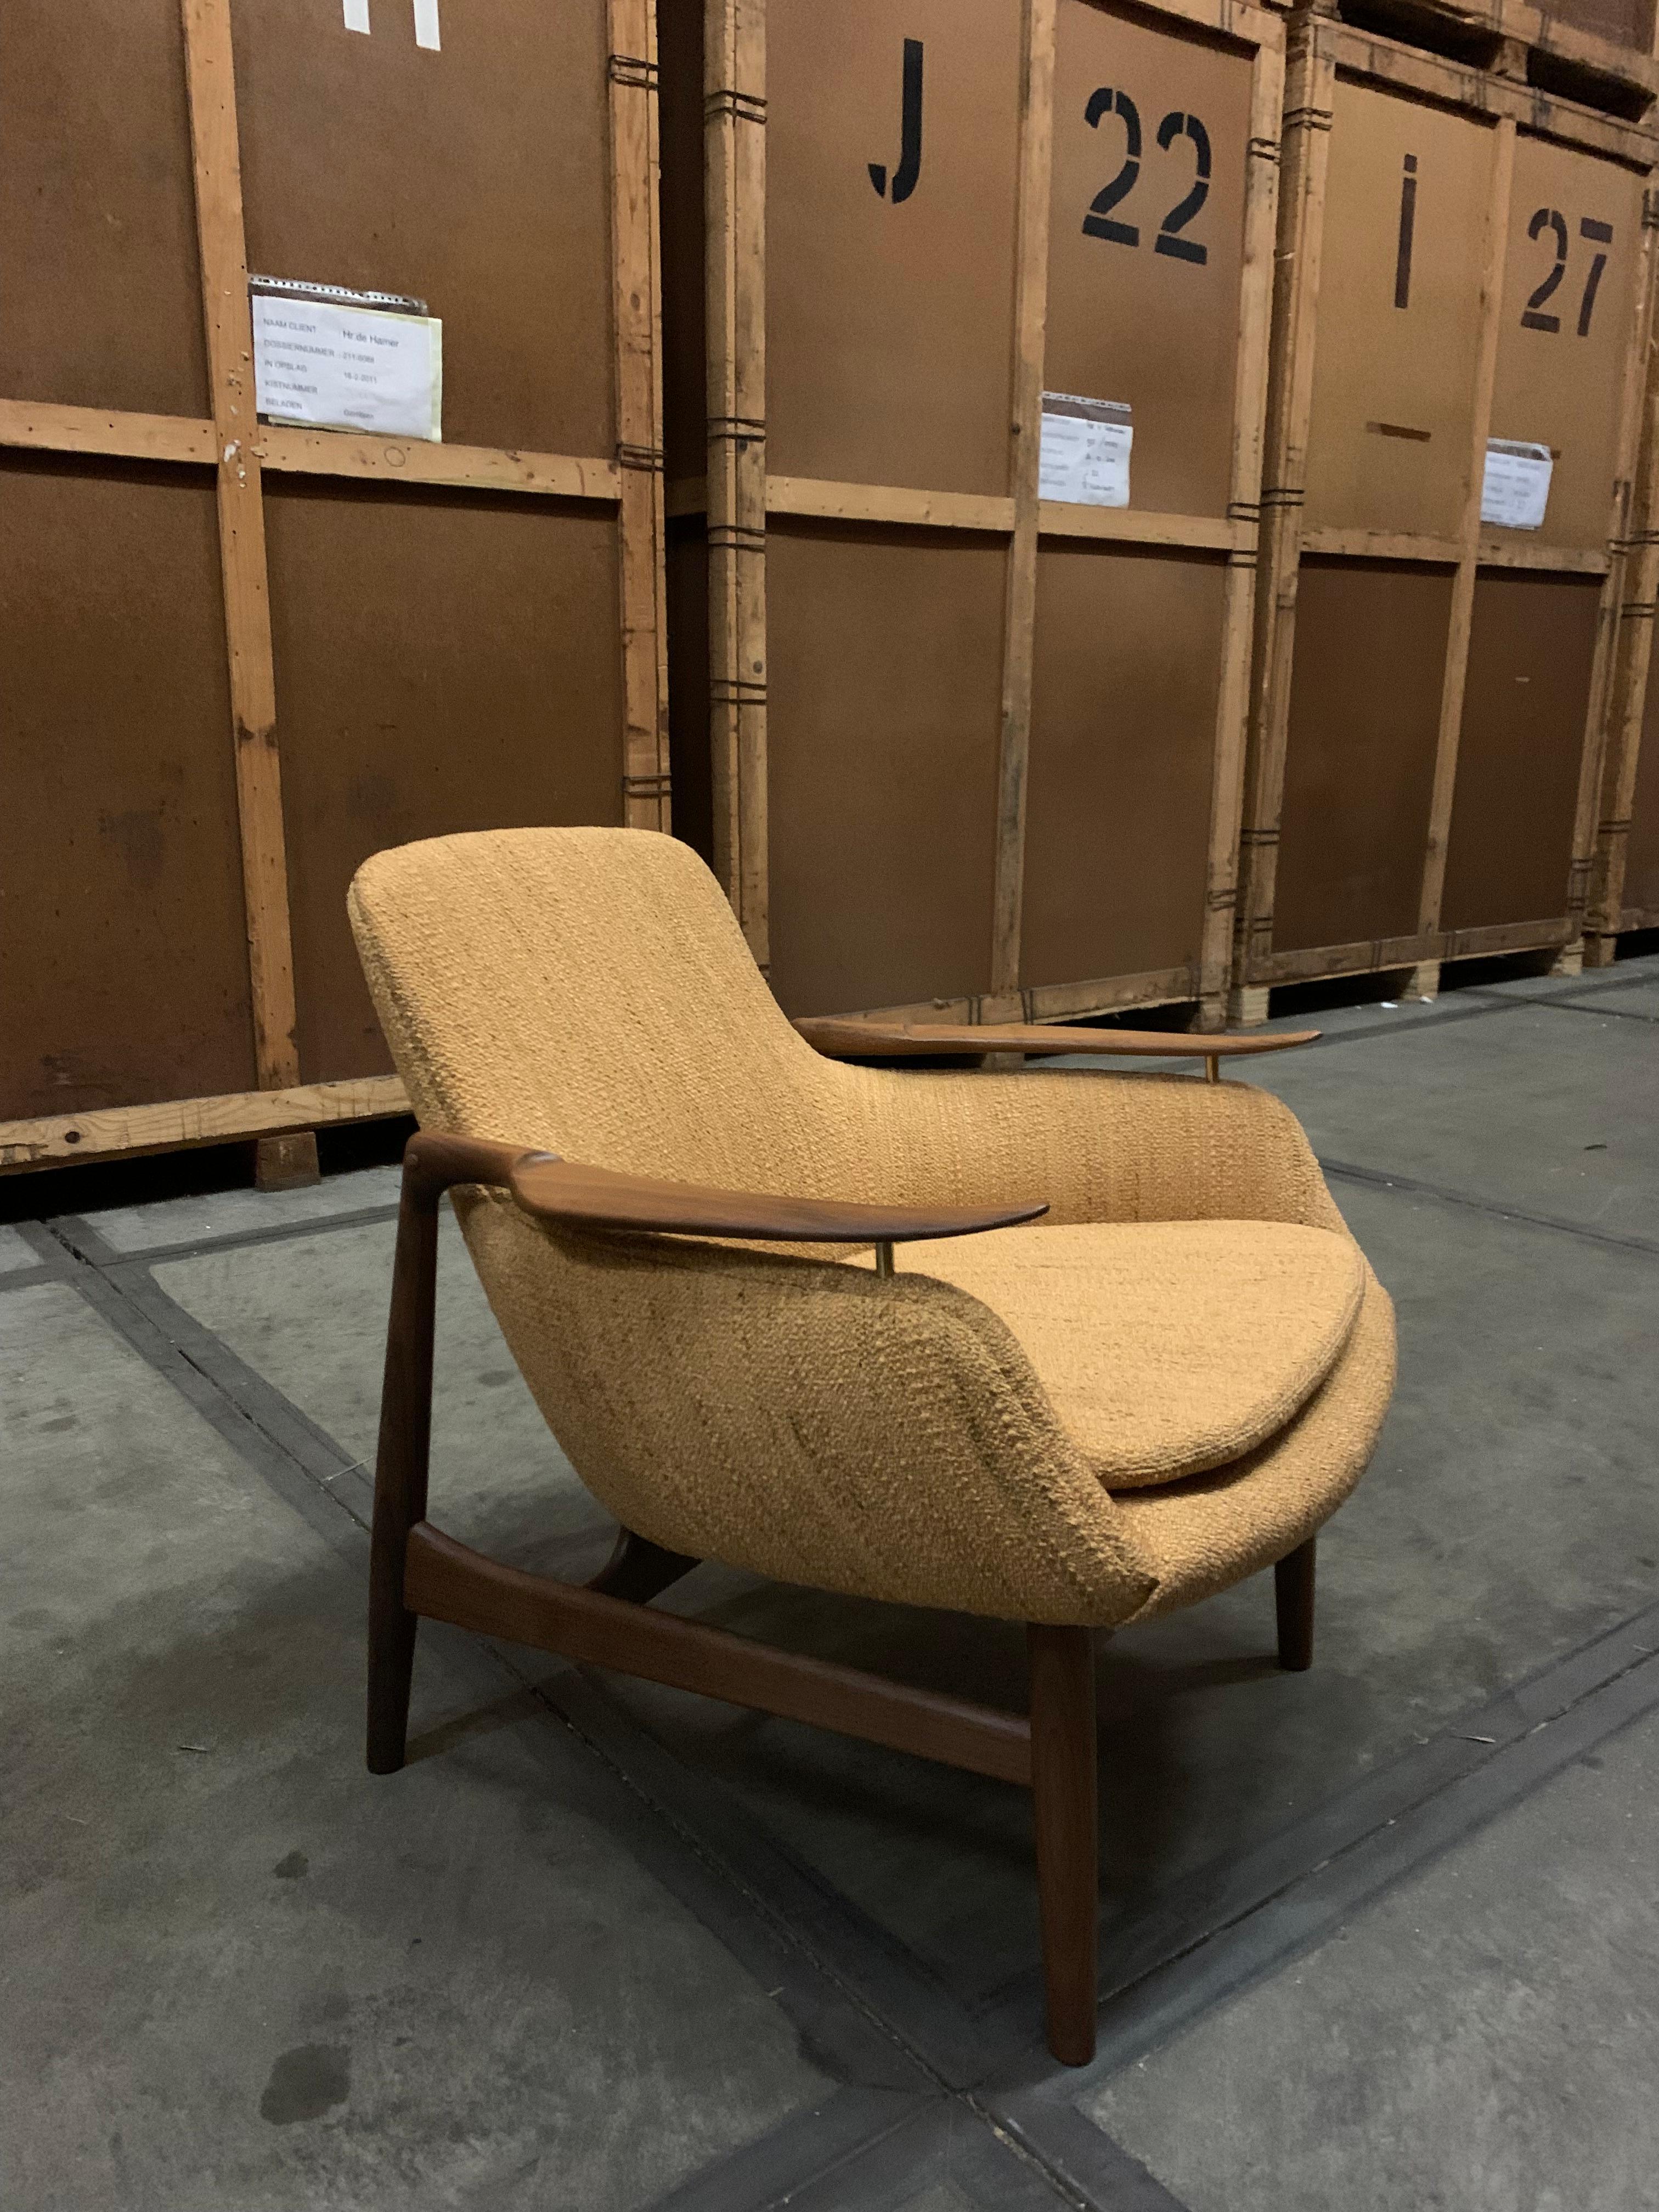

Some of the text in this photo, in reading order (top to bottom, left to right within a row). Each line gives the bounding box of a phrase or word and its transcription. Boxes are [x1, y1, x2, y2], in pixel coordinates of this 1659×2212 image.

[868, 38, 1212, 265] J 22
[1521, 208, 1613, 337] 27
